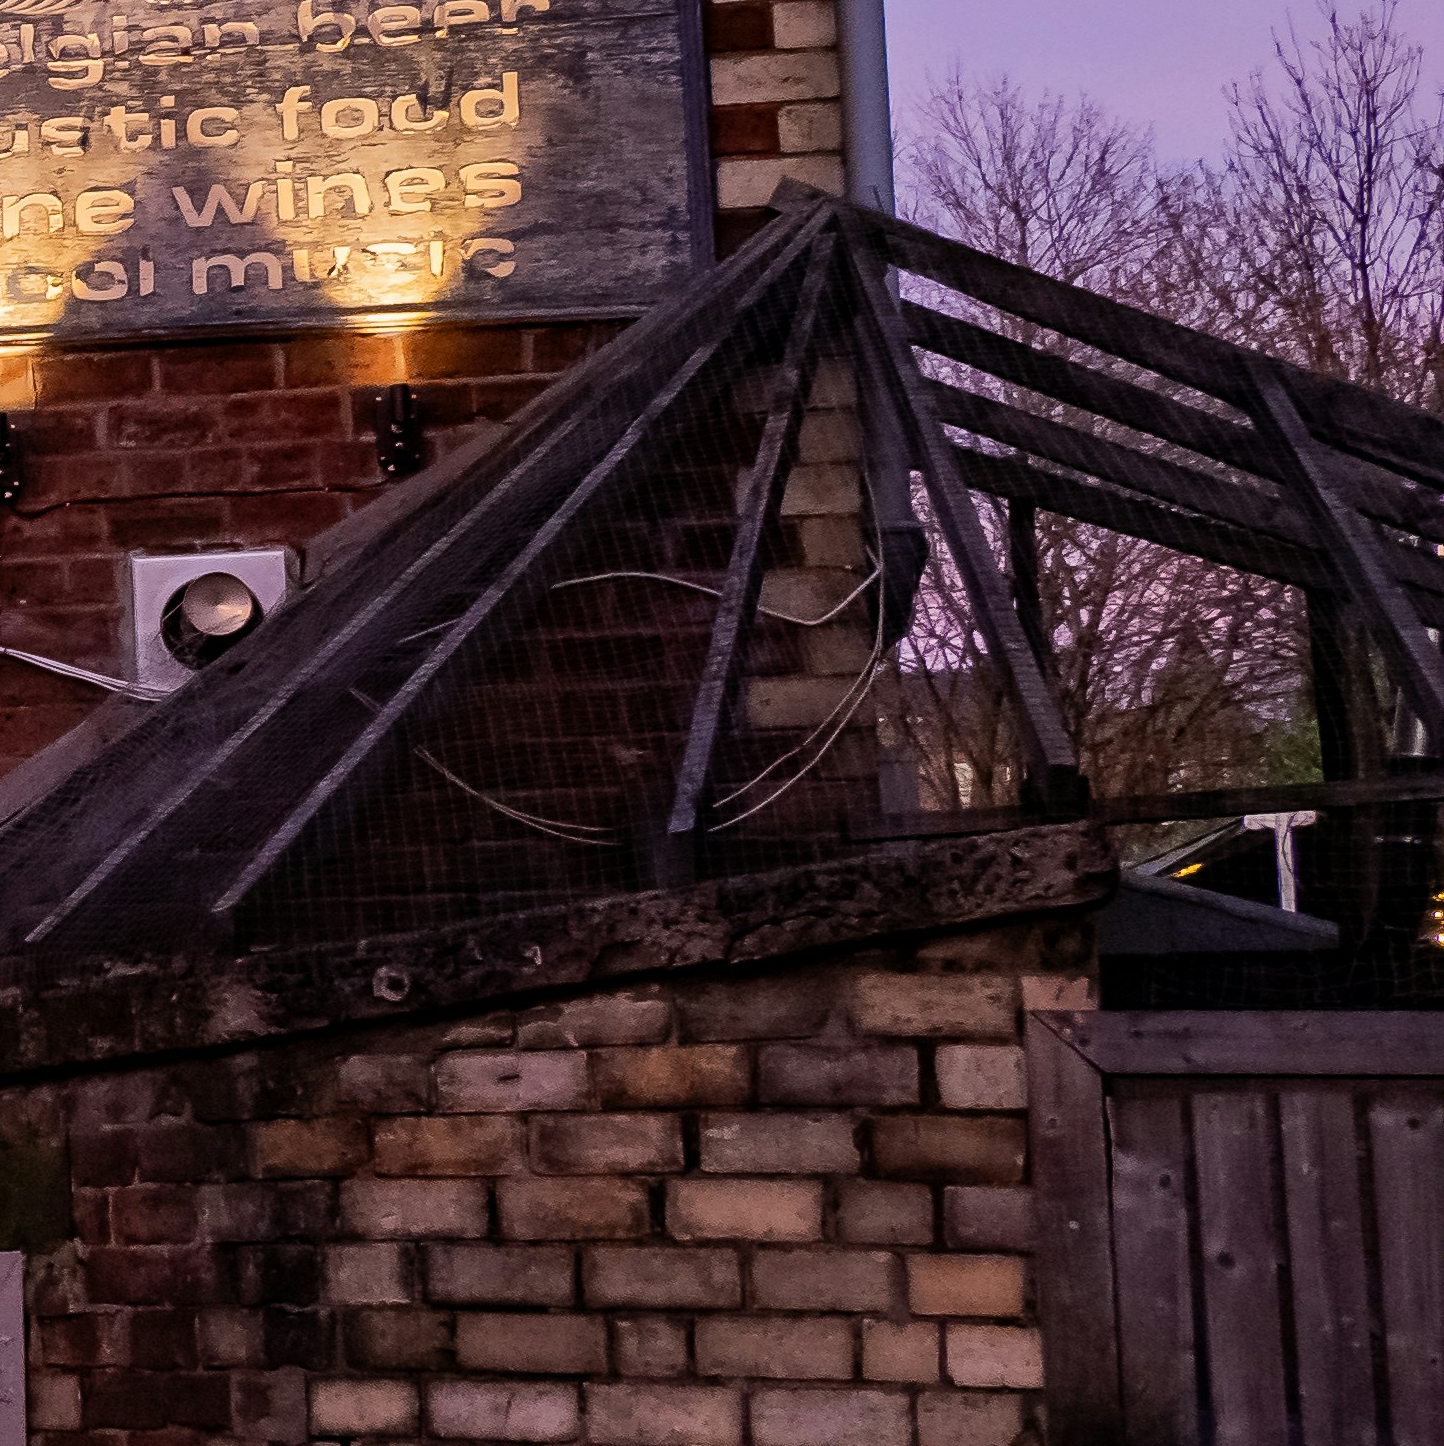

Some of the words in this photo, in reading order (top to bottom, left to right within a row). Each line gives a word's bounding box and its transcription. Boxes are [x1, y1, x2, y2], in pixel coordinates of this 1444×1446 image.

[276, 70, 521, 143] food
[171, 158, 522, 228] wines
[191, 235, 517, 296] music
